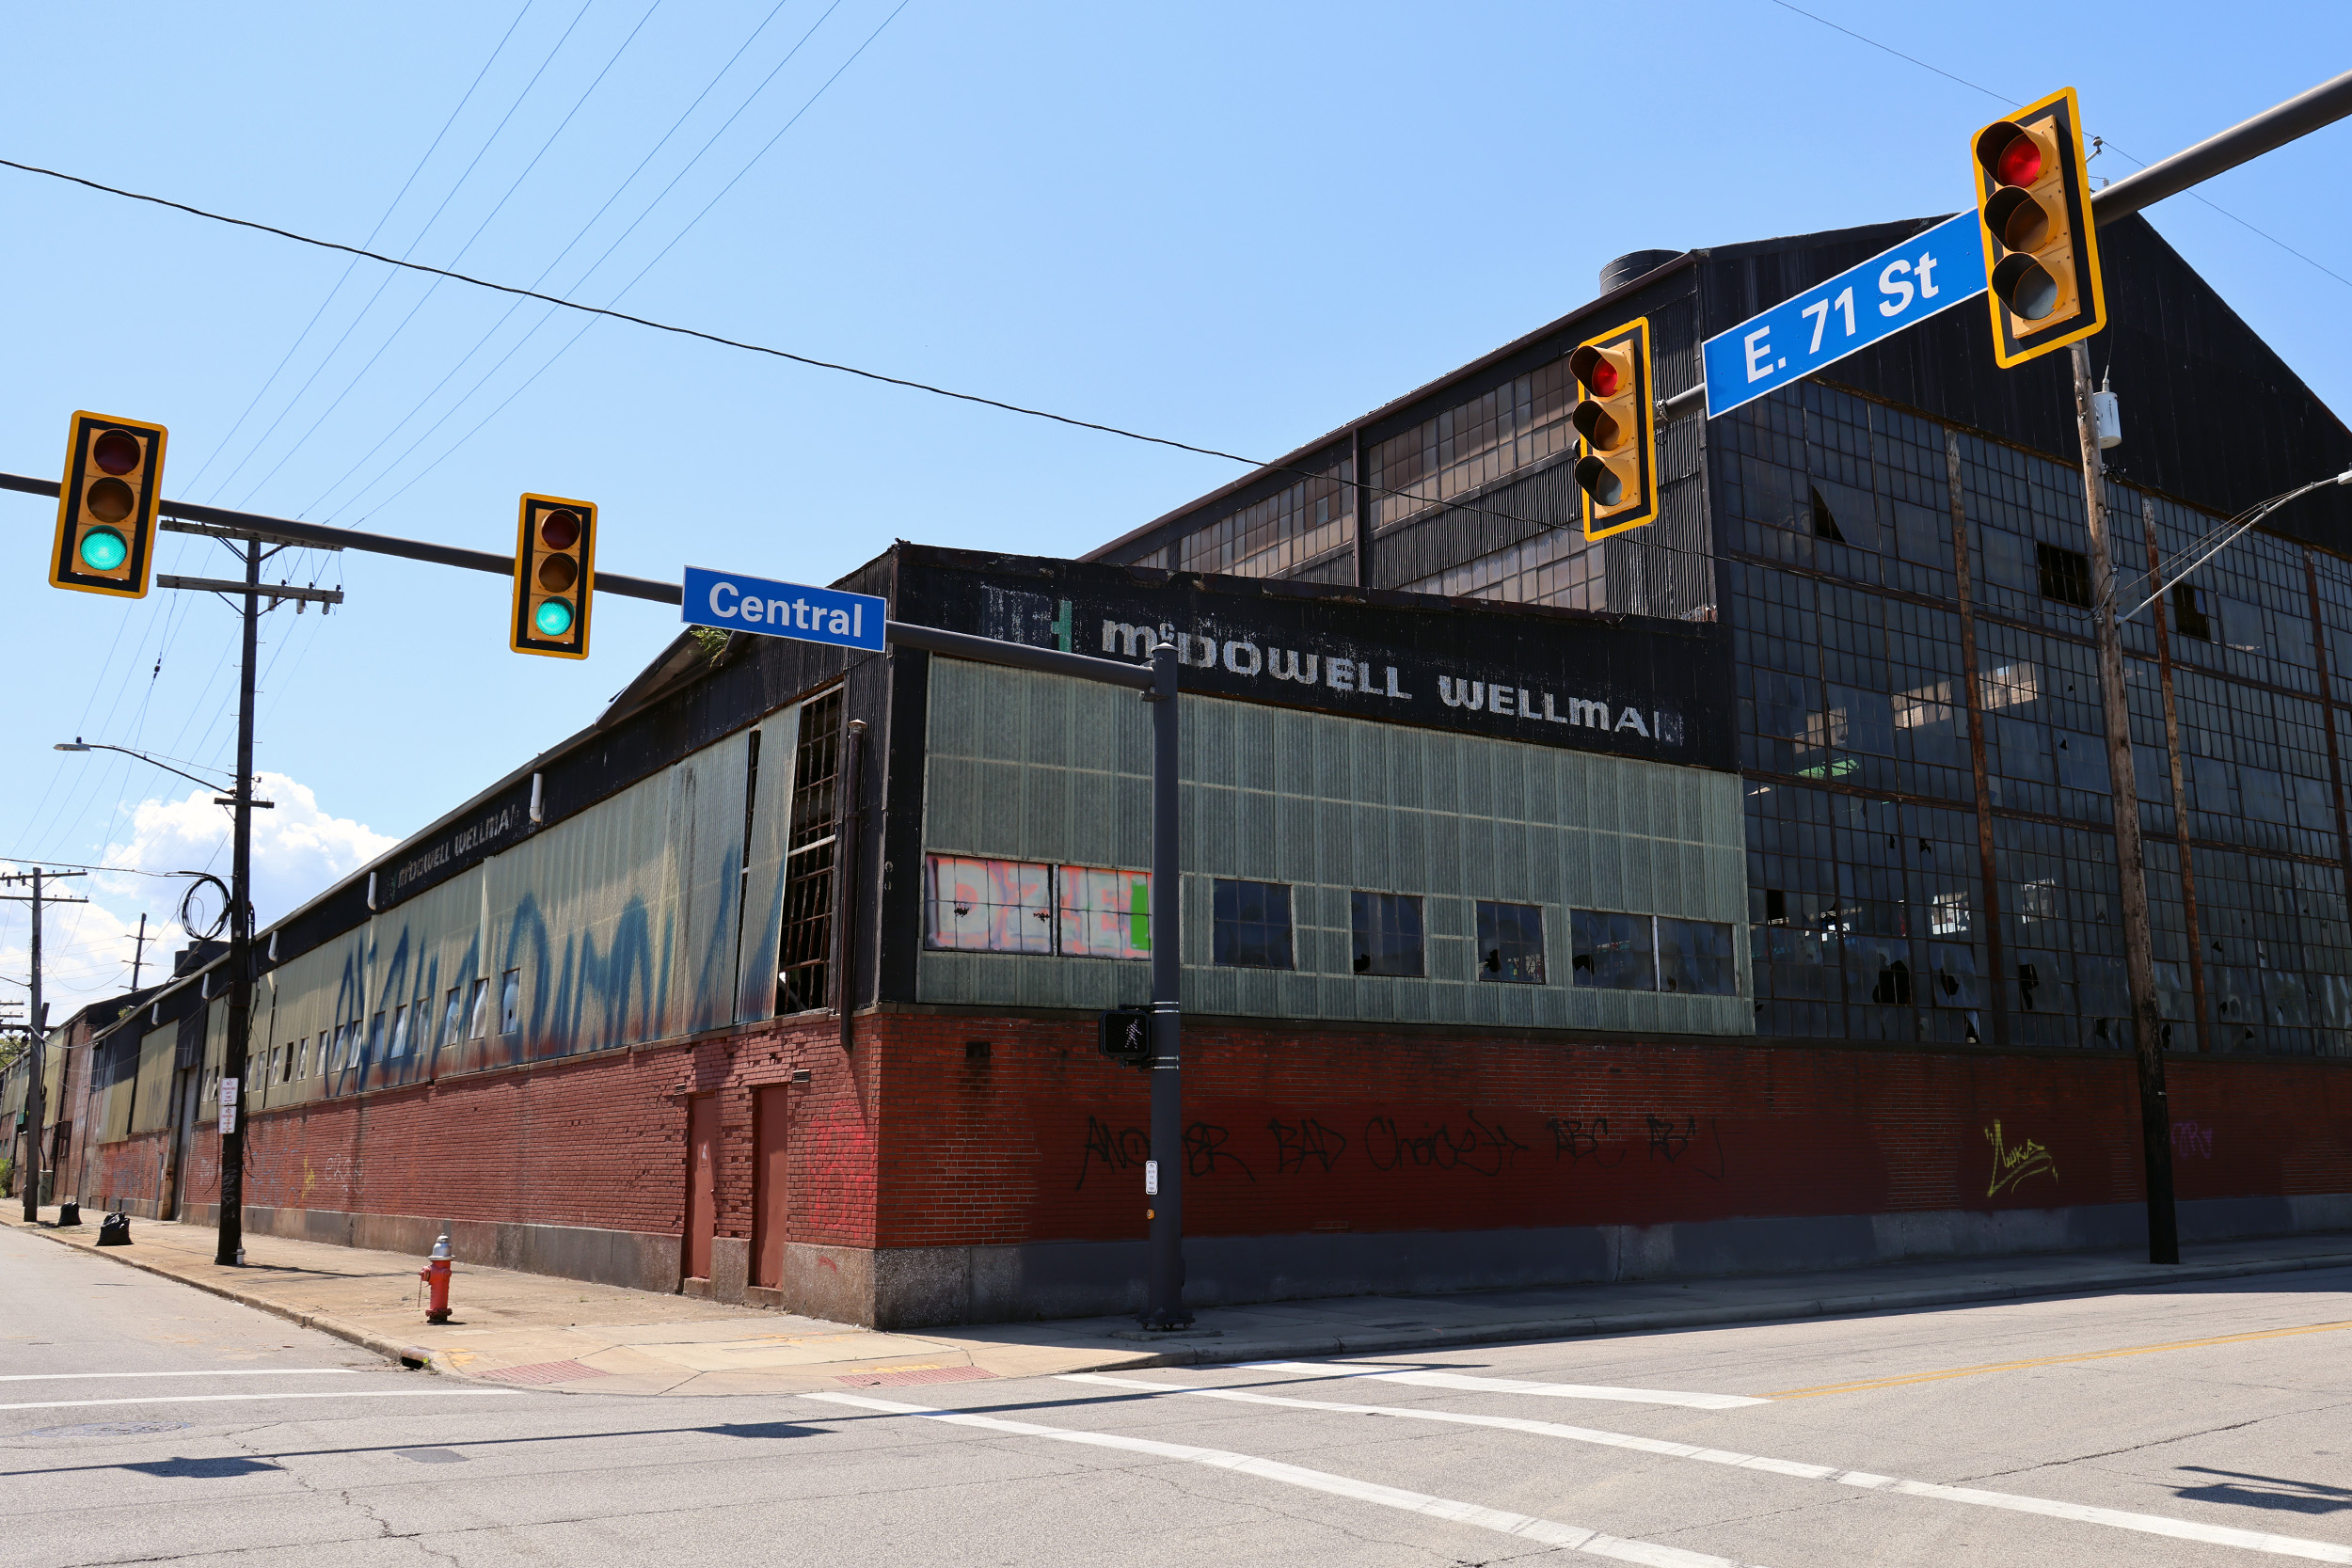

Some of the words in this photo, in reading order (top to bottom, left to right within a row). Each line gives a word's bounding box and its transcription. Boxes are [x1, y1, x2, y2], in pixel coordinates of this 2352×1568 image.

[1744, 325, 1787, 384] E.
[1802, 286, 1856, 355] 71
[1878, 251, 1939, 317] St
[708, 581, 863, 638] Central
